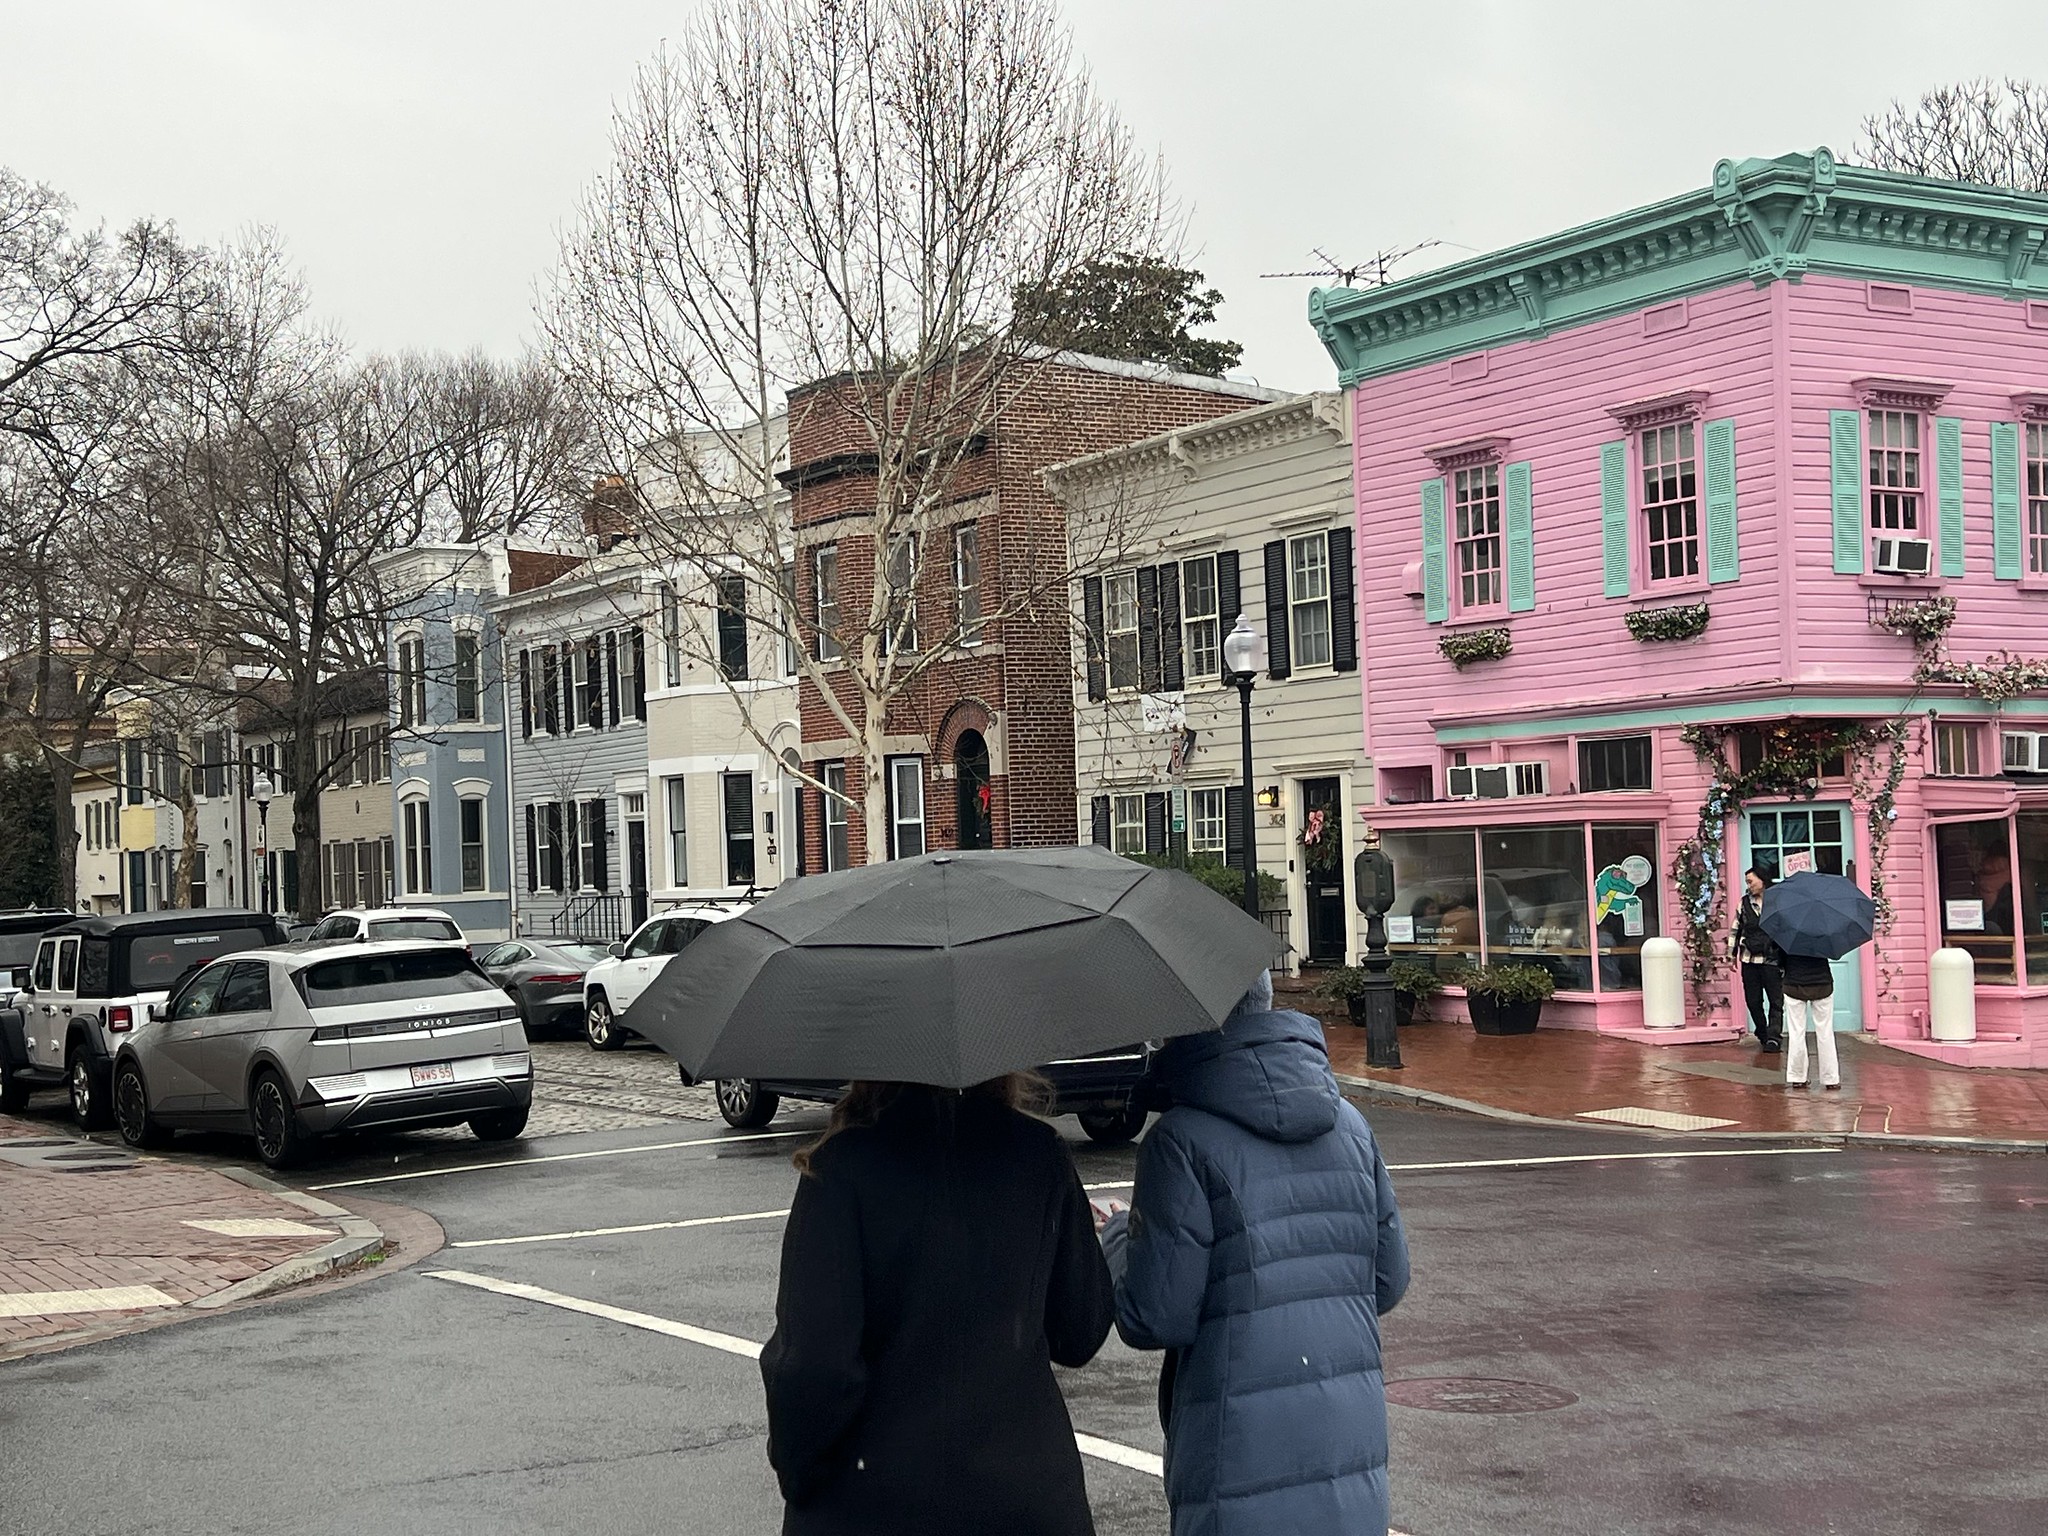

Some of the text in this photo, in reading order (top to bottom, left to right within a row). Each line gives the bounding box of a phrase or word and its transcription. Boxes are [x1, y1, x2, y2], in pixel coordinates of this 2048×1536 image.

[1788, 861, 1812, 872] OPEN
[413, 1068, 451, 1082] 5WWS 55
